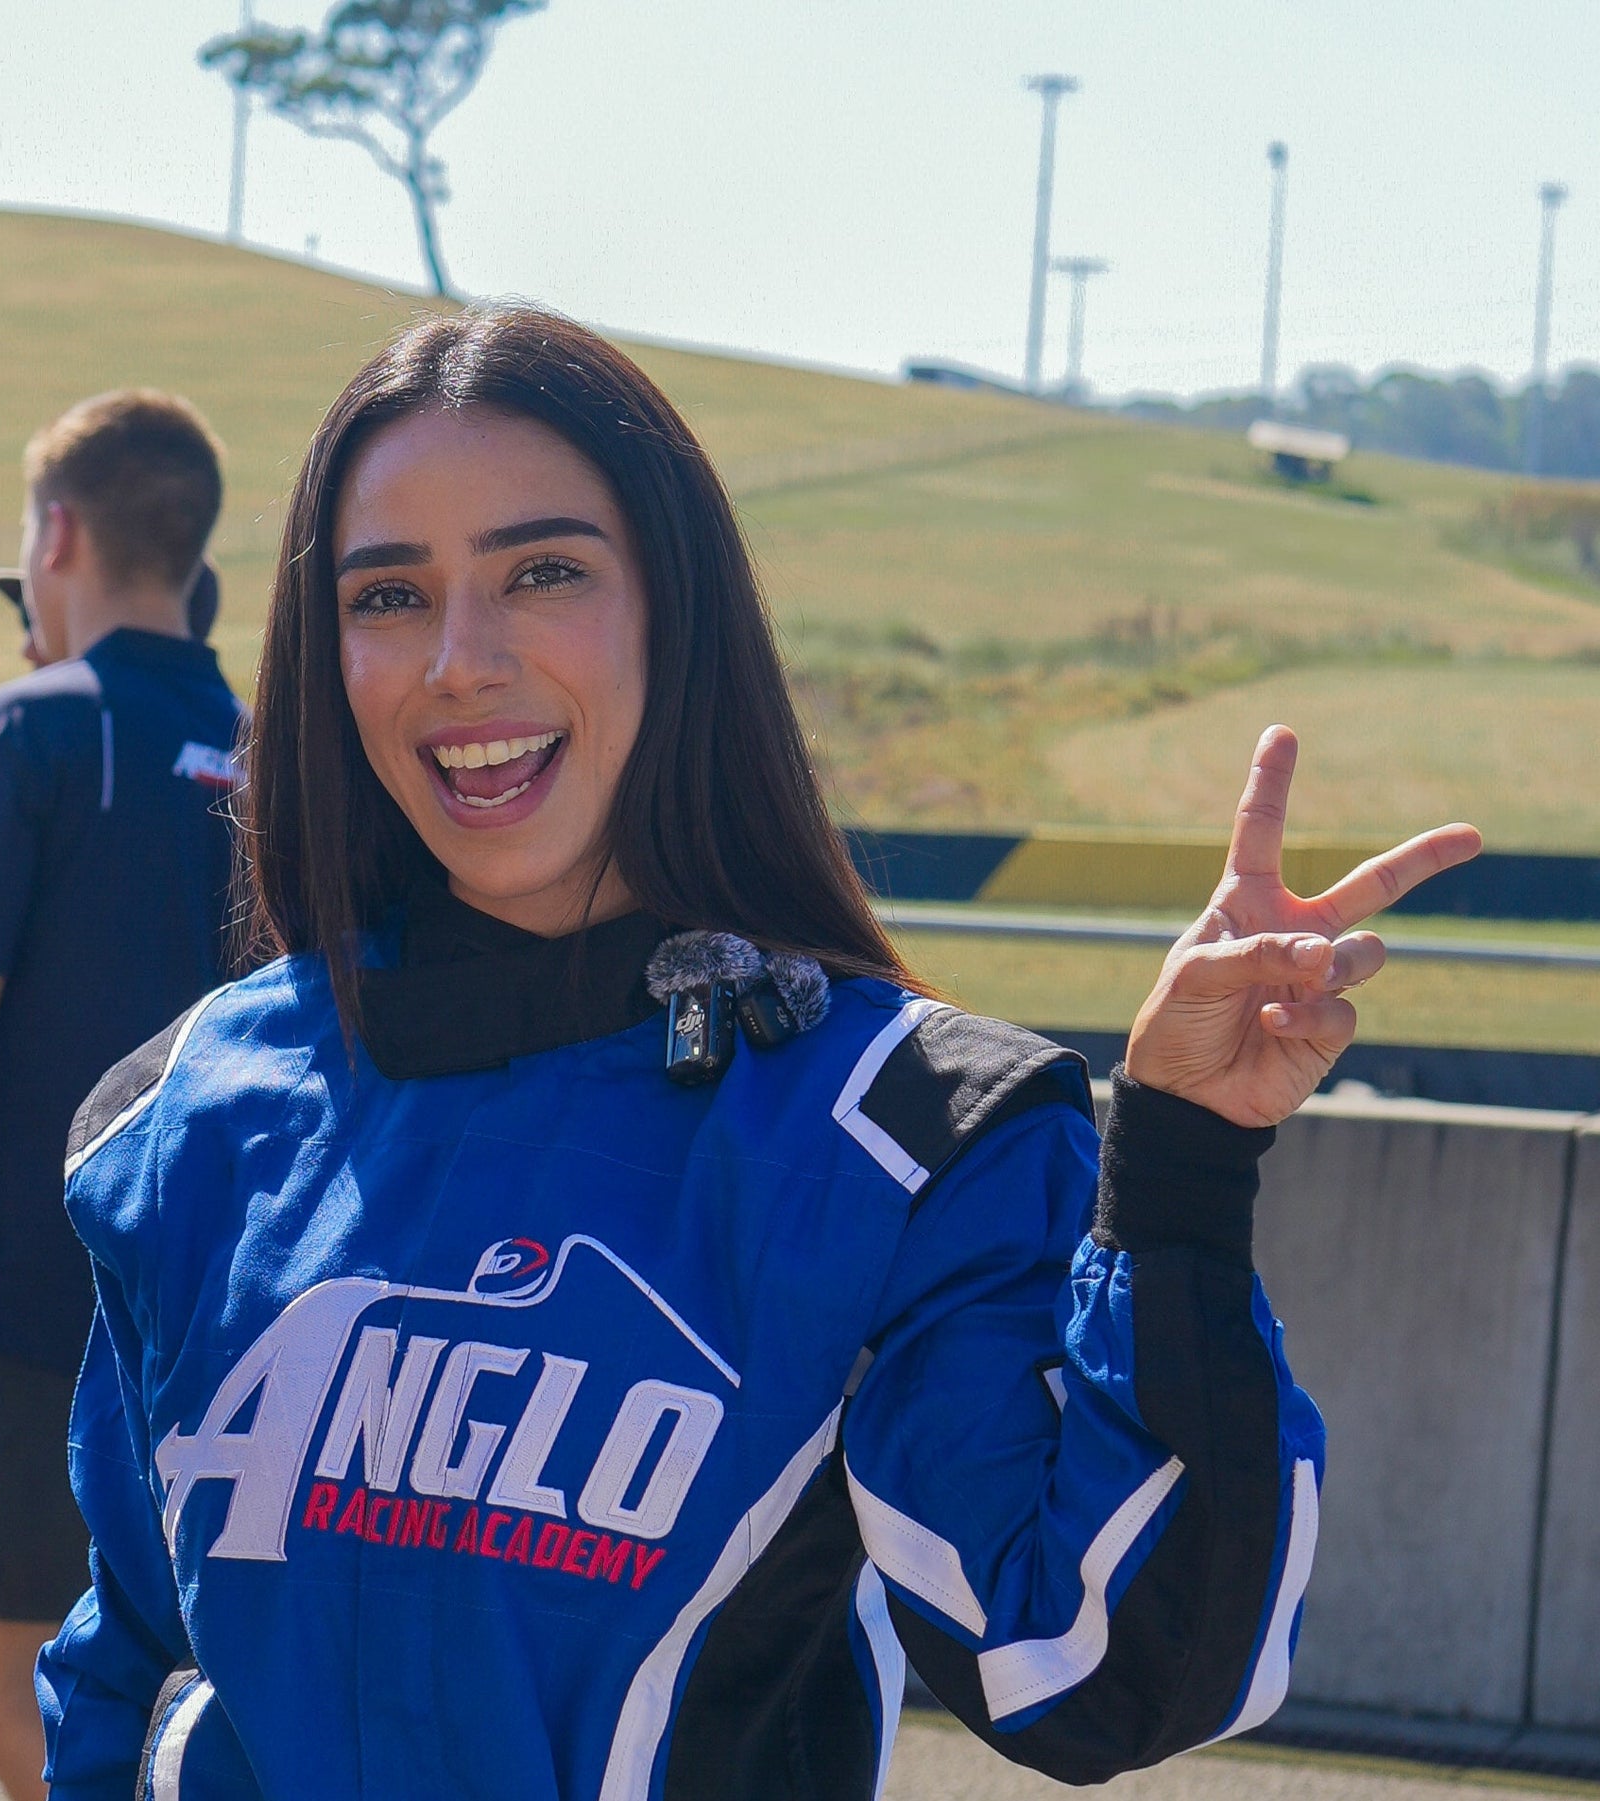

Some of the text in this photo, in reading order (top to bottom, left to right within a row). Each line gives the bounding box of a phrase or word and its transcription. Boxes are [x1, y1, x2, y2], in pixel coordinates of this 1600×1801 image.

[155, 1277, 725, 1562] ANGLO
[302, 1482, 667, 1591] RACING ACADEMY
